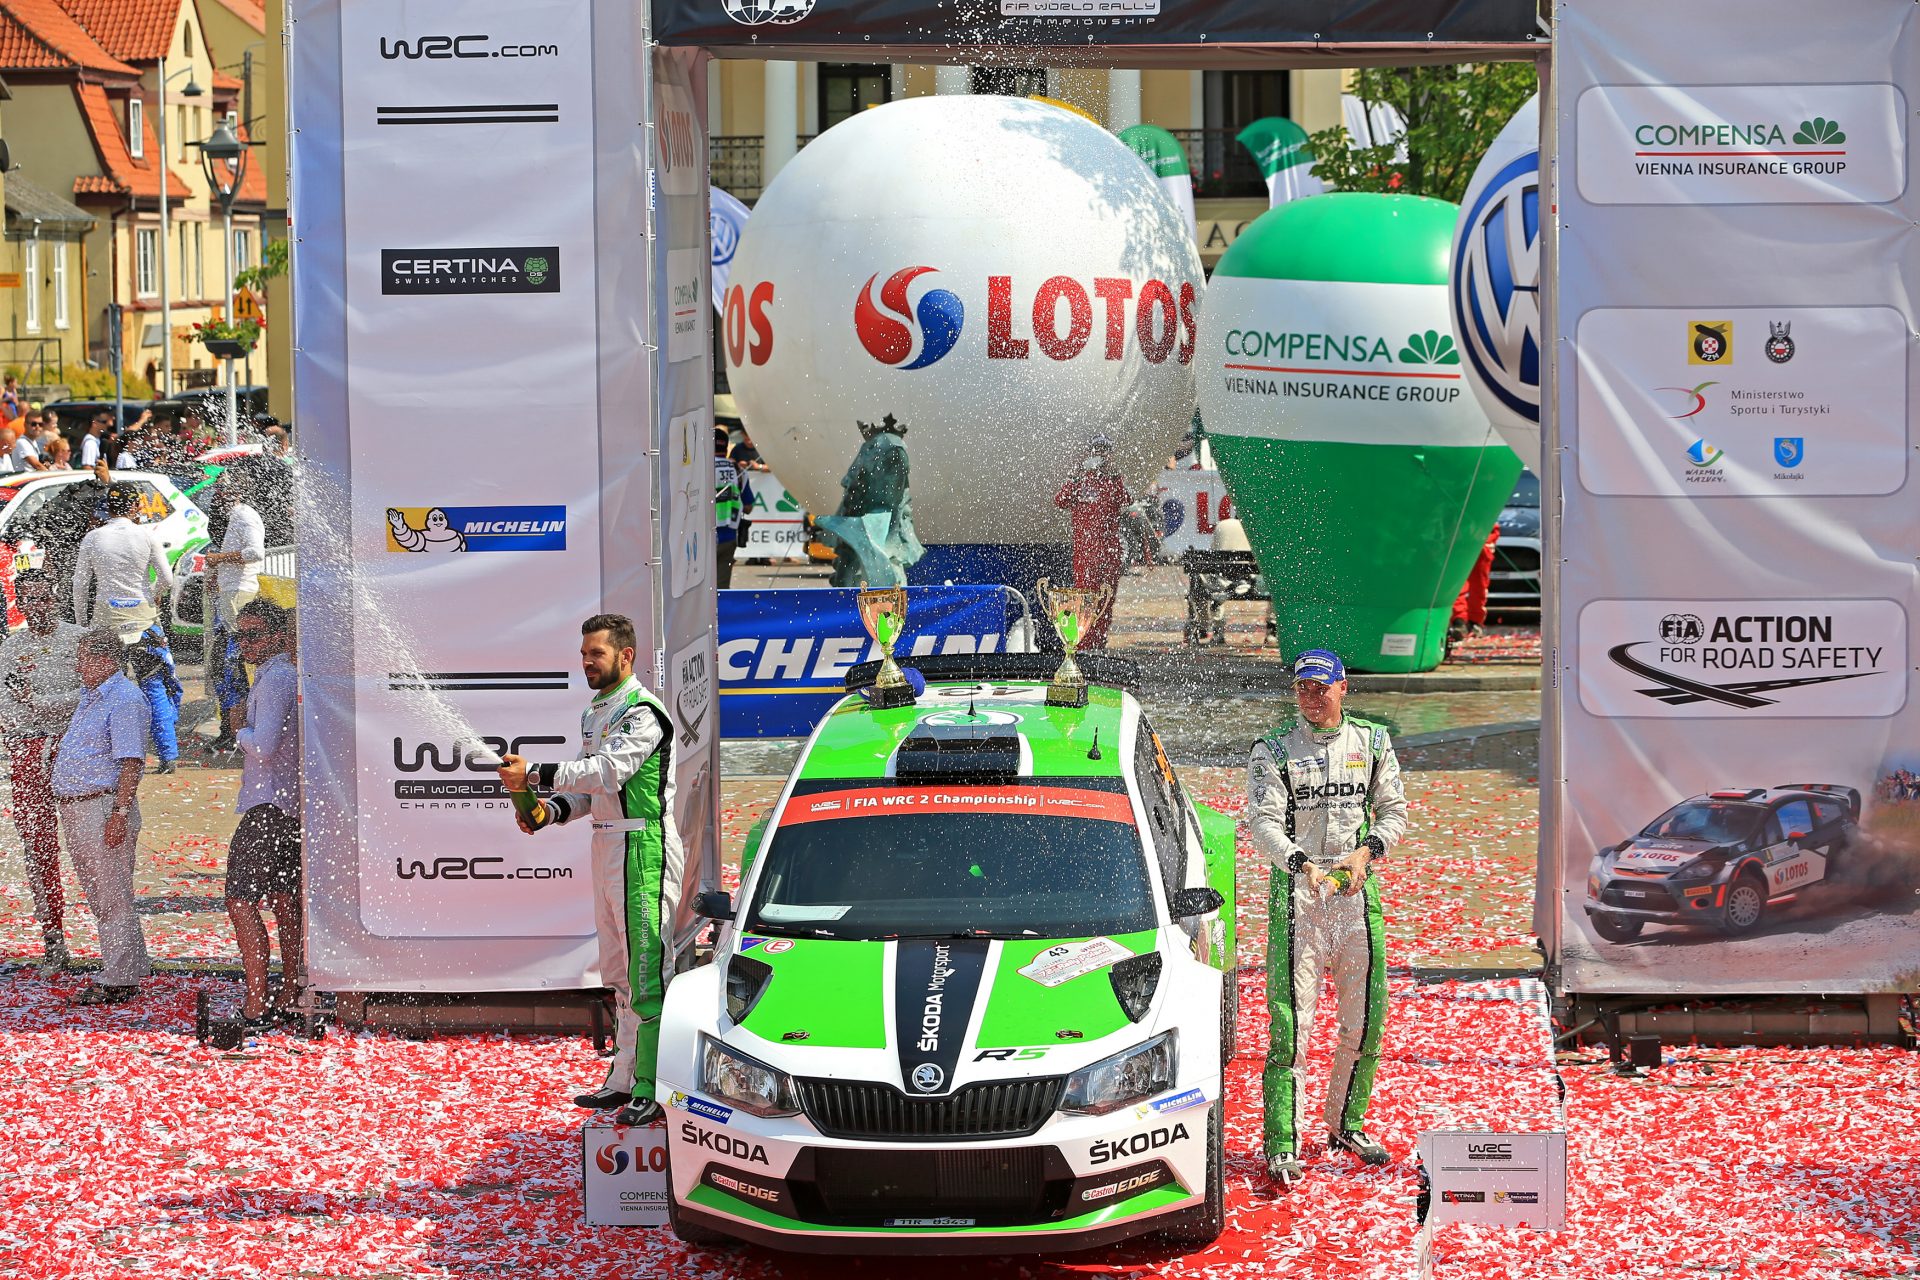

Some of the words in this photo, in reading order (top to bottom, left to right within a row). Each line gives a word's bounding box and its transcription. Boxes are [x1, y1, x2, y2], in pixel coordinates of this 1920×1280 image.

[1634, 124, 1786, 147] COMPENSA
[1635, 162, 1694, 175] VIENNA
[1698, 161, 1788, 175] INSURANCE
[1793, 161, 1846, 175] GROUP
[391, 258, 520, 275] CERTINA
[394, 277, 441, 285] SWISS
[449, 276, 517, 284] WATCHES
[988, 275, 1197, 367] LOTOS
[1224, 328, 1393, 364] COMPENSA
[1701, 352, 1720, 361] PZM
[1224, 377, 1279, 396] VIENNA
[1283, 380, 1391, 401] INSURANCE
[1396, 386, 1460, 403] GROUP
[1730, 390, 1805, 400] Ministerstwo
[1730, 405, 1768, 417] Sportu
[1779, 404, 1830, 417] Turystyki
[464, 520, 566, 533] MICHELIN
[1709, 616, 1832, 643] ACTION
[1660, 648, 1697, 663] FOR
[1702, 647, 1775, 669] ROAD
[1781, 646, 1883, 669] SAFETY
[399, 785, 426, 794] FIA
[431, 785, 495, 794] WORLD
[1295, 782, 1367, 801] ŠKODA
[853, 797, 878, 808] FIA
[882, 795, 915, 806] WRC
[919, 794, 929, 805] 2
[933, 794, 1037, 807] Championship
[1641, 851, 1680, 863] LOTOS
[1784, 861, 1809, 883] LOTOS
[1048, 946, 1070, 958] 43
[927, 944, 953, 991] Motorsport
[916, 993, 944, 1052] ŠKODA
[972, 1047, 1051, 1062] R5
[691, 1102, 731, 1119] MICHELIN
[1159, 1092, 1204, 1111] MICHELIN
[681, 1119, 770, 1166] ŠKODA
[1089, 1122, 1190, 1166] ŠKODA
[1468, 1143, 1513, 1153] WRC
[717, 1175, 737, 1189] Castrol
[737, 1182, 780, 1202] EDGE
[1089, 1185, 1116, 1199] Castrol
[1116, 1169, 1162, 1194] EDGE
